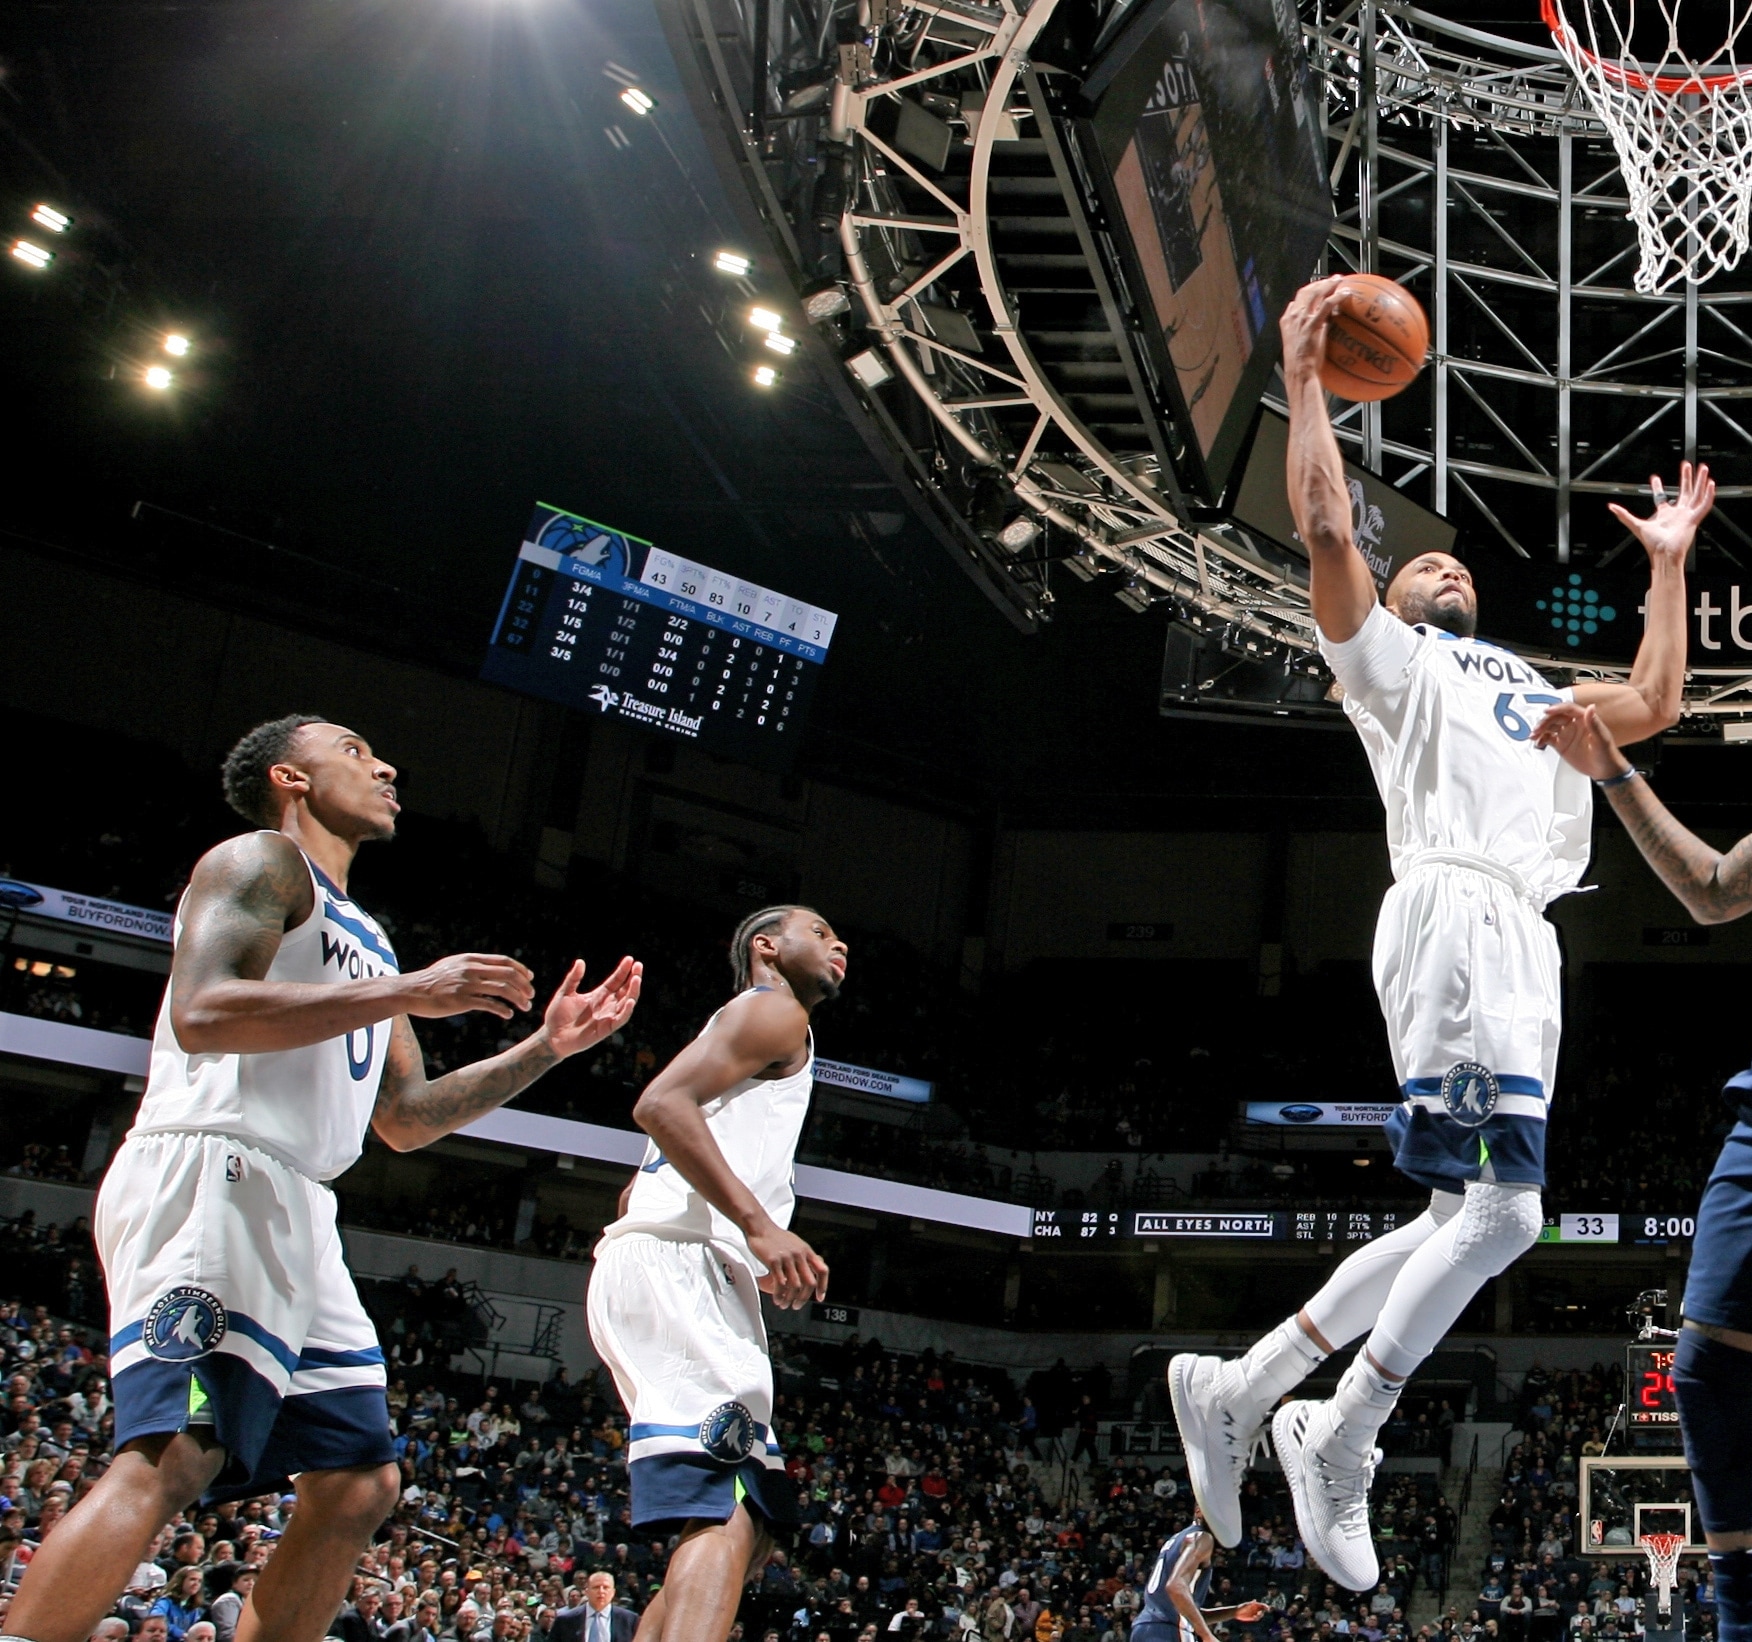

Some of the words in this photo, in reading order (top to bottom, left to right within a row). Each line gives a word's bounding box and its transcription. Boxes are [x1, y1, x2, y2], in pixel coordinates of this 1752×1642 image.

[571, 581, 593, 597] 3/4
[622, 600, 641, 613] 1/1
[668, 616, 688, 630] 2/2
[651, 572, 667, 585] 43
[680, 582, 696, 595] 50
[709, 592, 724, 605] 83
[737, 602, 750, 615] 10
[567, 598, 587, 613] 1/3
[617, 615, 637, 630] 1/2
[664, 632, 683, 645] 0/0
[562, 614, 582, 629] 1/5
[610, 631, 630, 645] 0/1
[658, 647, 678, 661] 3/4
[706, 612, 725, 624] BLK
[732, 622, 751, 633] AST
[754, 628, 774, 642] REB
[798, 644, 816, 656] PTS
[555, 630, 577, 645] 2/4
[606, 647, 625, 661] 1/1
[652, 663, 673, 677] 0/0
[550, 646, 572, 661] 3/5
[600, 663, 620, 677] 0/0
[648, 679, 668, 692] 0/0
[622, 692, 666, 719] Treasure
[668, 708, 704, 730] Island
[68, 906, 170, 937] BUYFORDNOW.
[814, 1068, 892, 1092] YFORDNOW.COM
[1341, 1113, 1387, 1122] BUYFORD
[1035, 1211, 1055, 1222] NY
[1082, 1213, 1098, 1222] 82
[1142, 1220, 1168, 1230] ALL
[1176, 1220, 1212, 1230] EYES
[1219, 1220, 1273, 1231] NORTH
[1296, 1213, 1316, 1221] REB
[1327, 1213, 1337, 1221] 10
[1577, 1218, 1604, 1235] 33
[1644, 1218, 1695, 1236] 8:00
[1034, 1226, 1061, 1236] CHA
[1080, 1227, 1097, 1237] 87
[824, 1309, 848, 1322] 138
[1649, 1412, 1679, 1421] TISS
